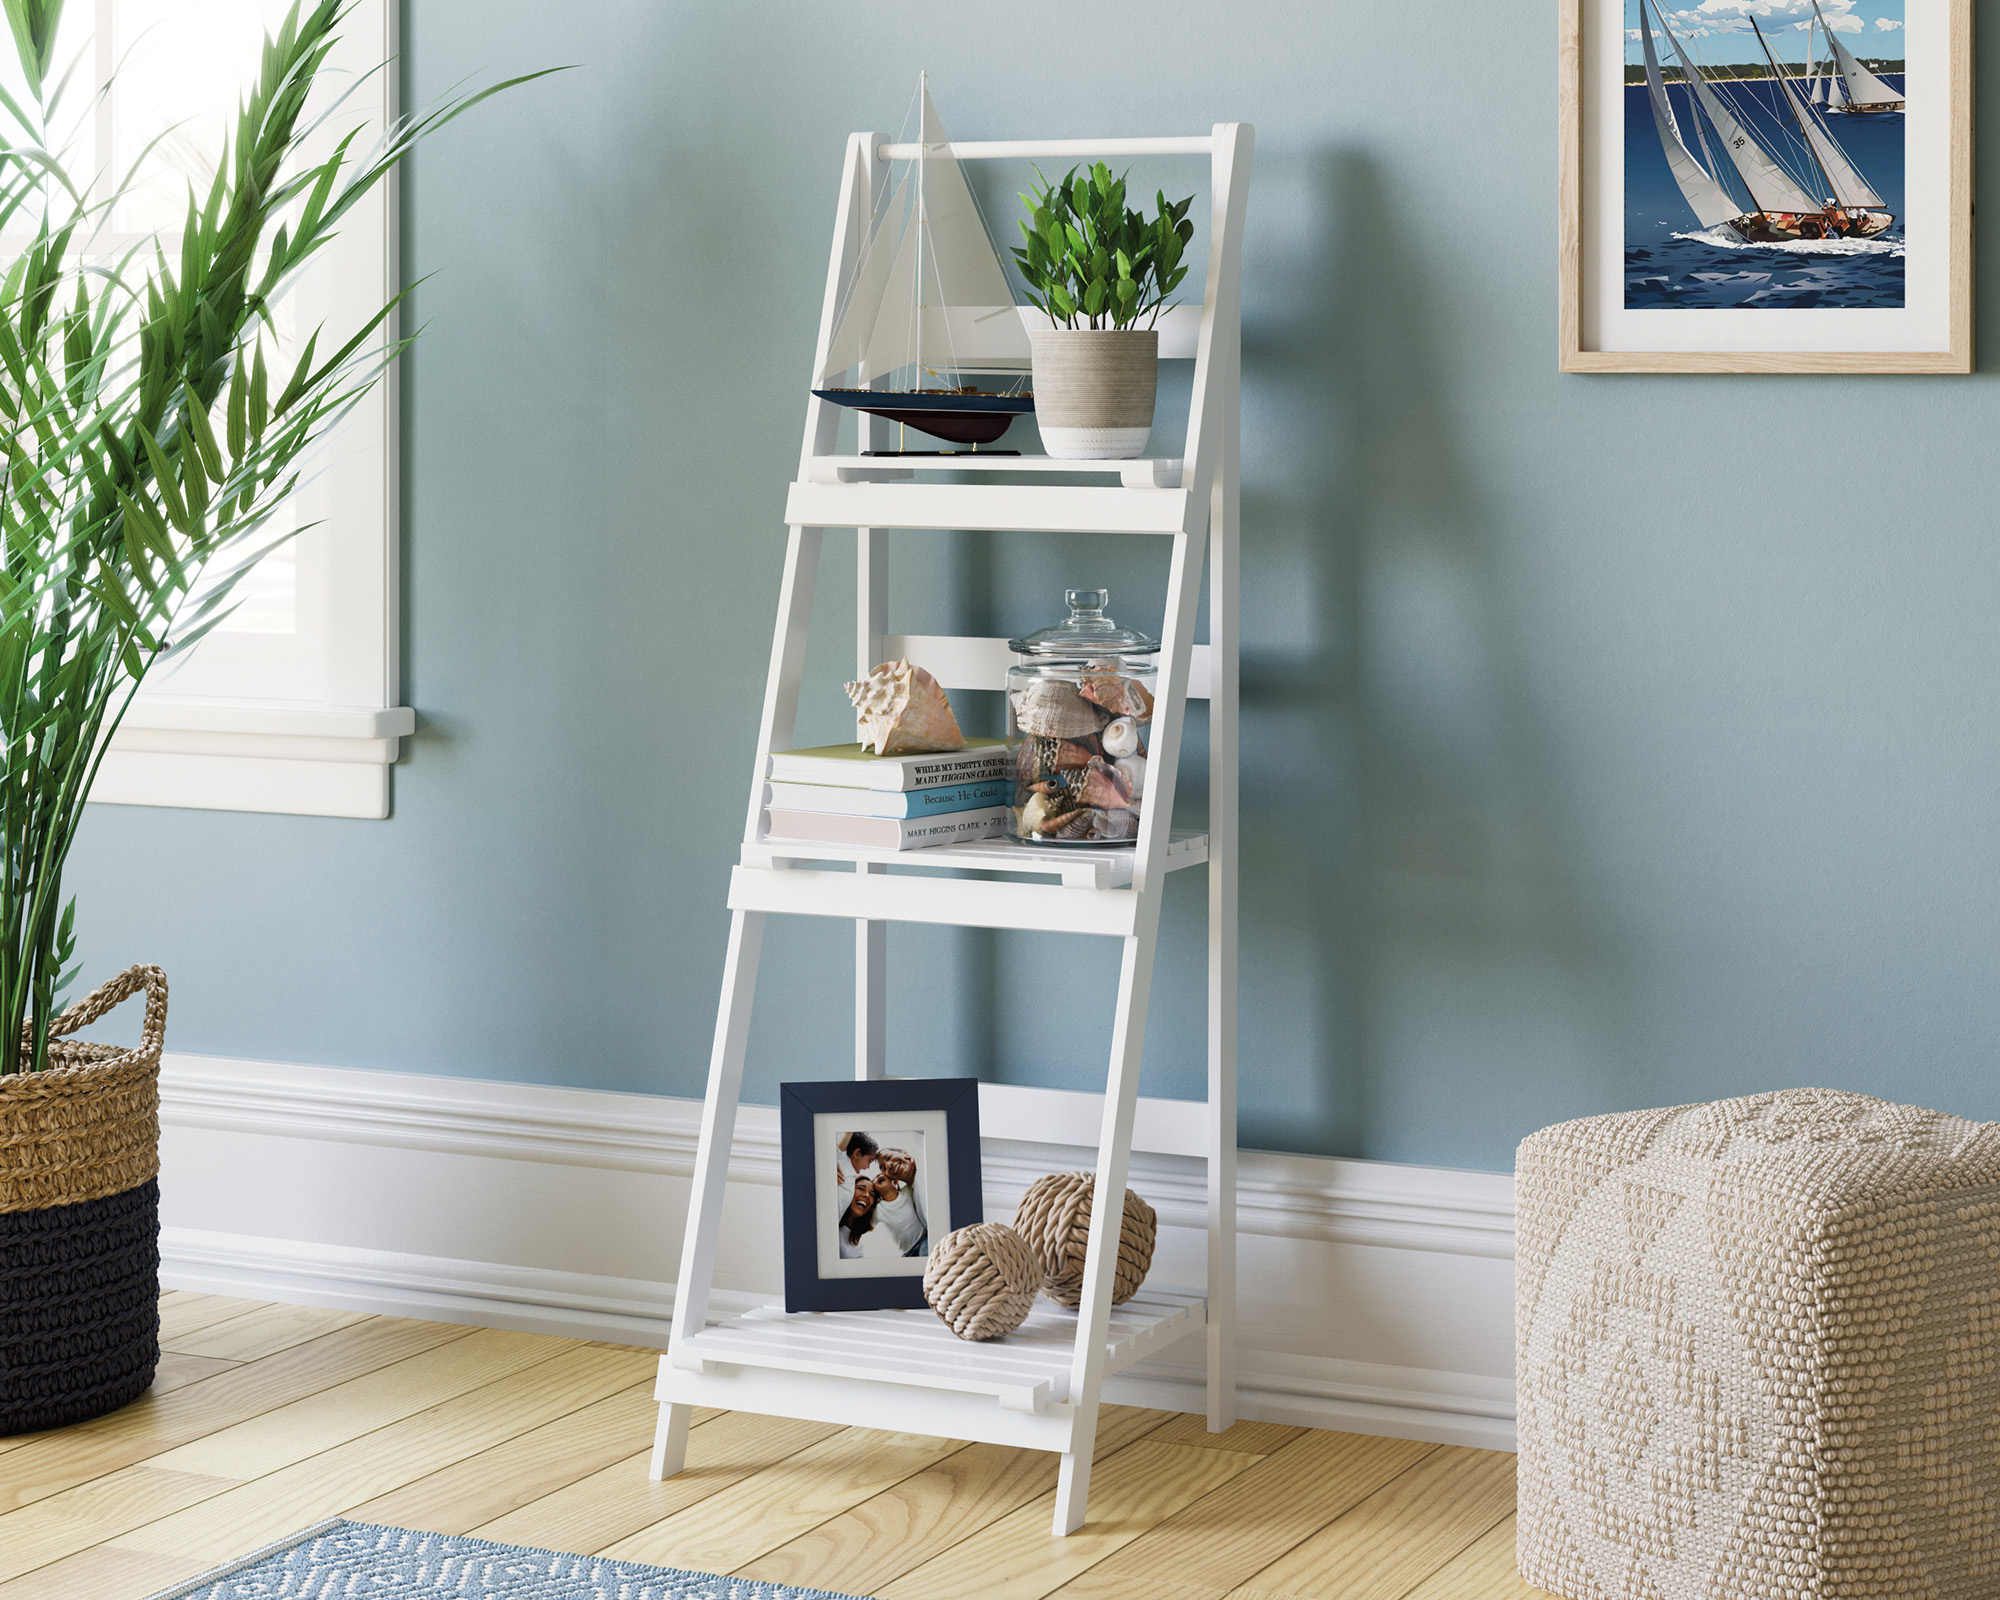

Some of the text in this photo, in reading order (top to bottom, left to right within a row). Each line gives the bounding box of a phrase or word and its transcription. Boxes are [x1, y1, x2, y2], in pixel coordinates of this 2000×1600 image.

[1733, 136, 1745, 149] 35
[914, 765, 941, 775] WHILE
[942, 763, 953, 772] MY
[954, 760, 982, 770] PRETTY
[915, 768, 1004, 786] MARY HIGGINS CLARK
[923, 794, 955, 805] Because
[957, 790, 971, 801] He
[973, 787, 998, 798] Could
[907, 828, 927, 838] MARY
[929, 824, 956, 835] HIGGINS
[958, 821, 980, 831] CLARK
